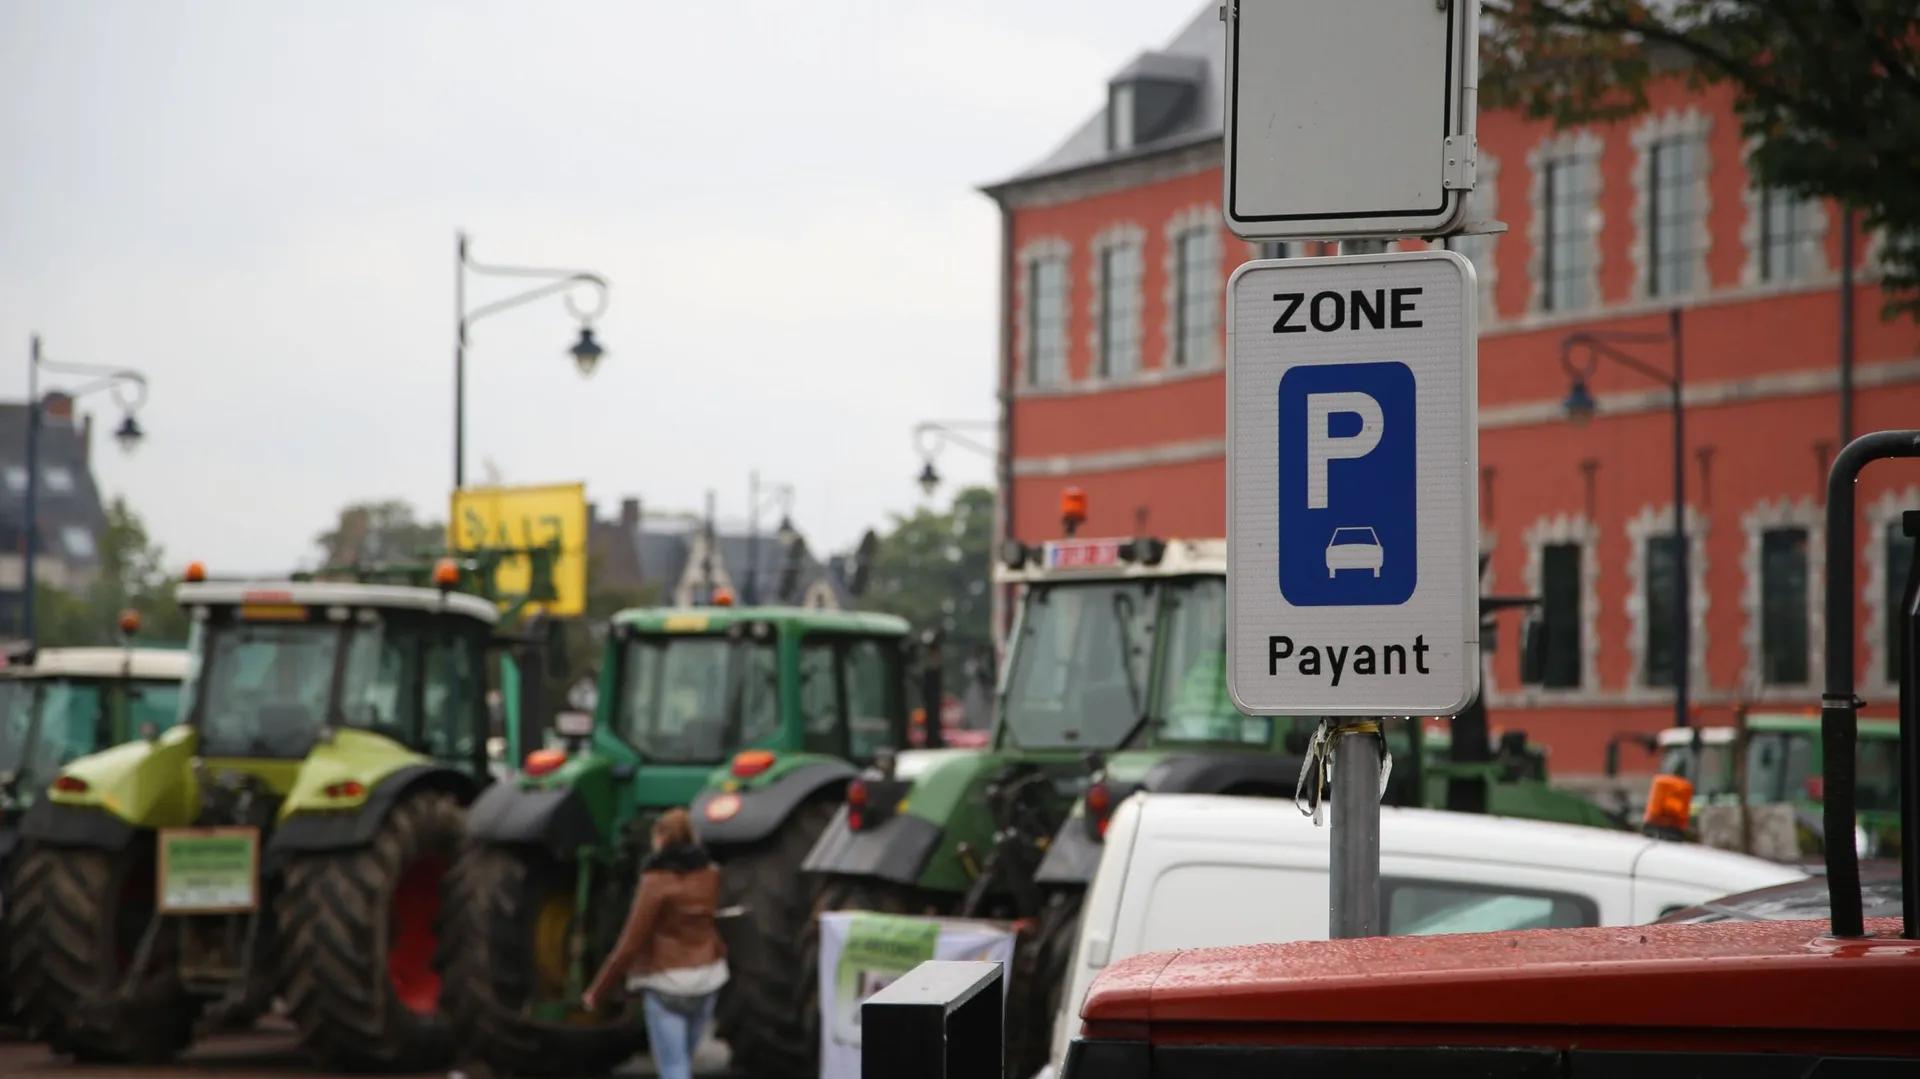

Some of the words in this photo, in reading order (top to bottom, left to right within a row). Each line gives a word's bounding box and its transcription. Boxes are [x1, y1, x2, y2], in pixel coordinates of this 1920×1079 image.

[1273, 287, 1423, 333] ZONE
[1307, 391, 1384, 509] P
[1269, 634, 1429, 686] Payant
